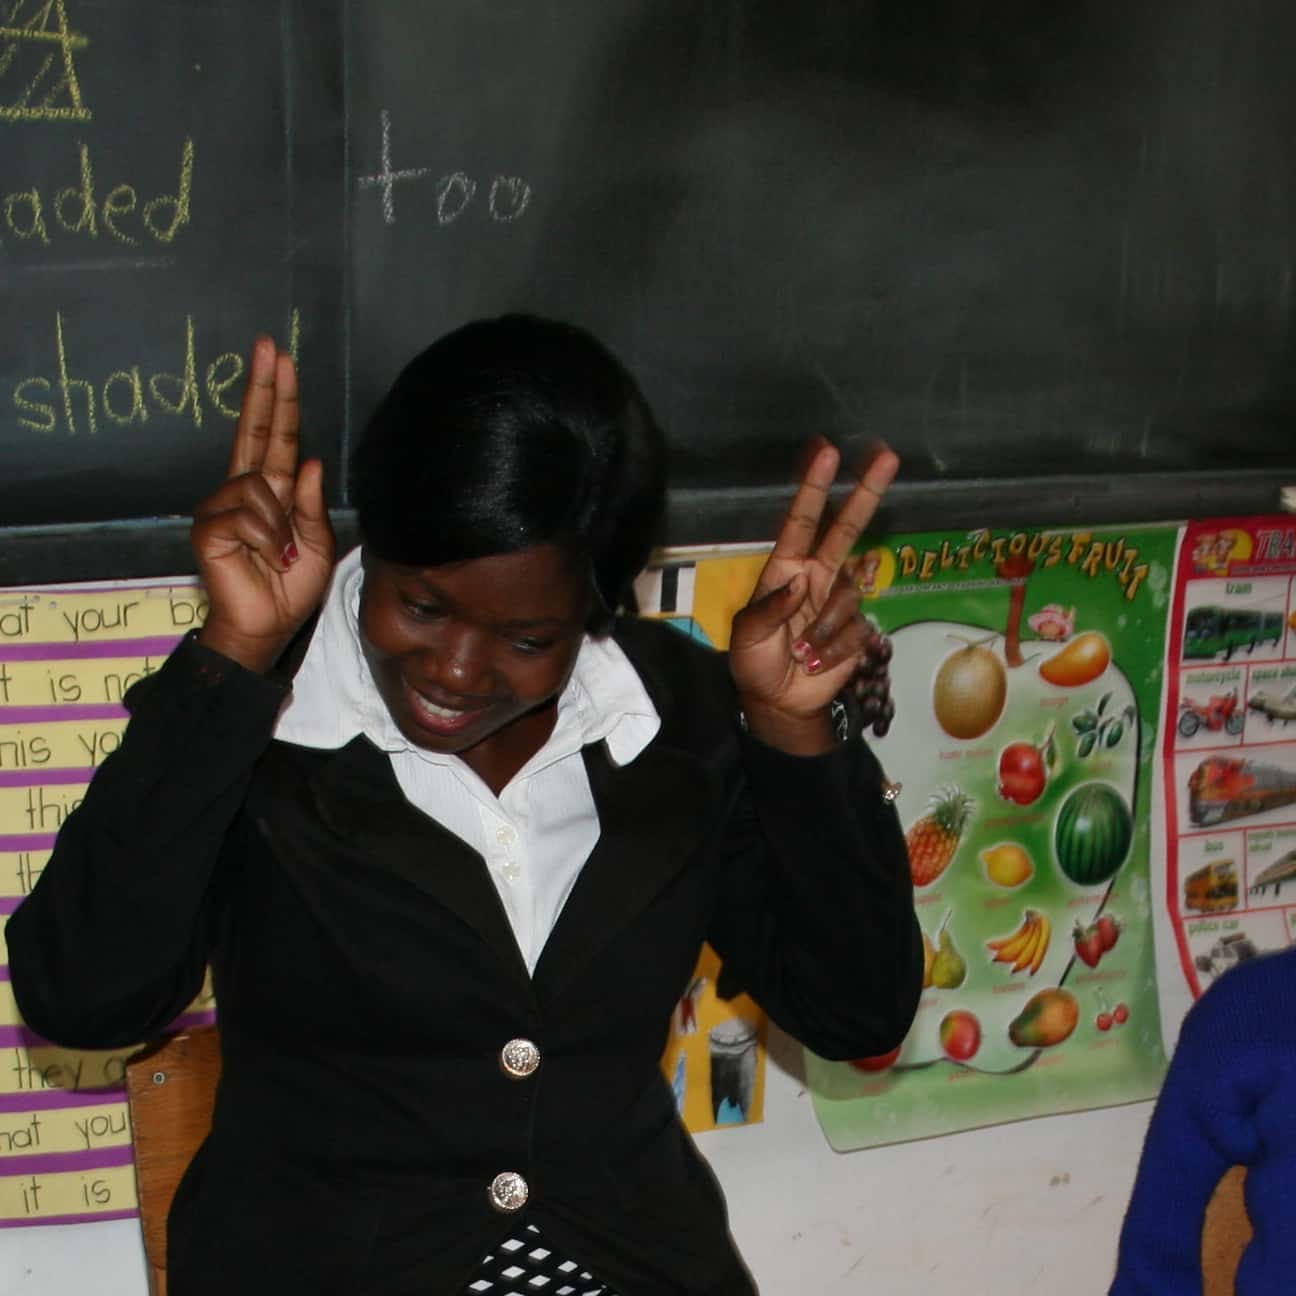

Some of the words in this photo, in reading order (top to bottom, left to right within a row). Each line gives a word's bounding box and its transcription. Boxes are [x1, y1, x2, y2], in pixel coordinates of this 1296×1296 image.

[357, 109, 531, 225] too
[63, 601, 140, 643] your
[48, 670, 82, 703] is
[77, 730, 125, 767] yo
[13, 1048, 83, 1090] they
[75, 1112, 126, 1149] you
[20, 1176, 41, 1213] it
[80, 1176, 111, 1205] is
